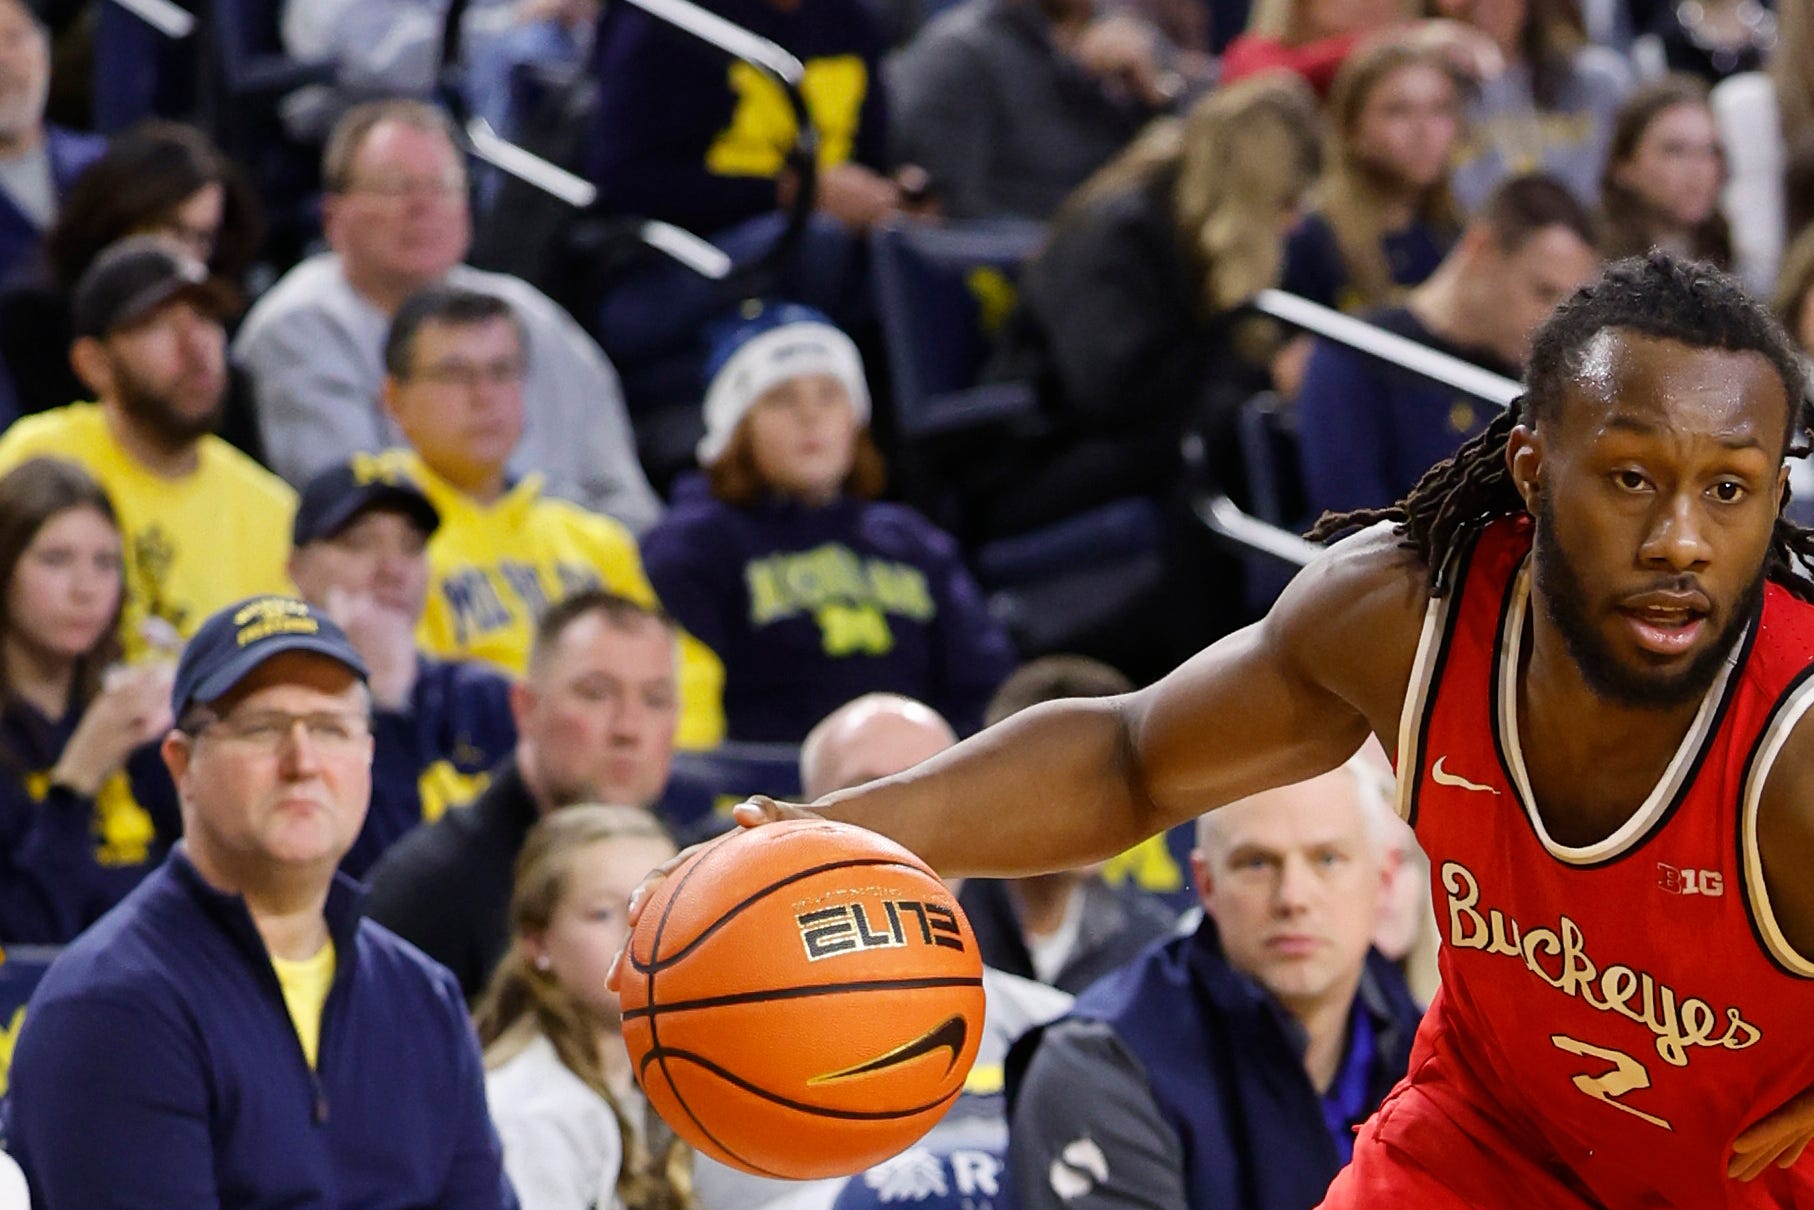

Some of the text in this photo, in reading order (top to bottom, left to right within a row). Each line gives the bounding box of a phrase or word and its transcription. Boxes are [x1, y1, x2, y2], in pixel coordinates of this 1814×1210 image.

[795, 899, 965, 962] ELITE
[1441, 861, 1762, 1067] Buckeyes
[1550, 1033, 1673, 1132] 2
